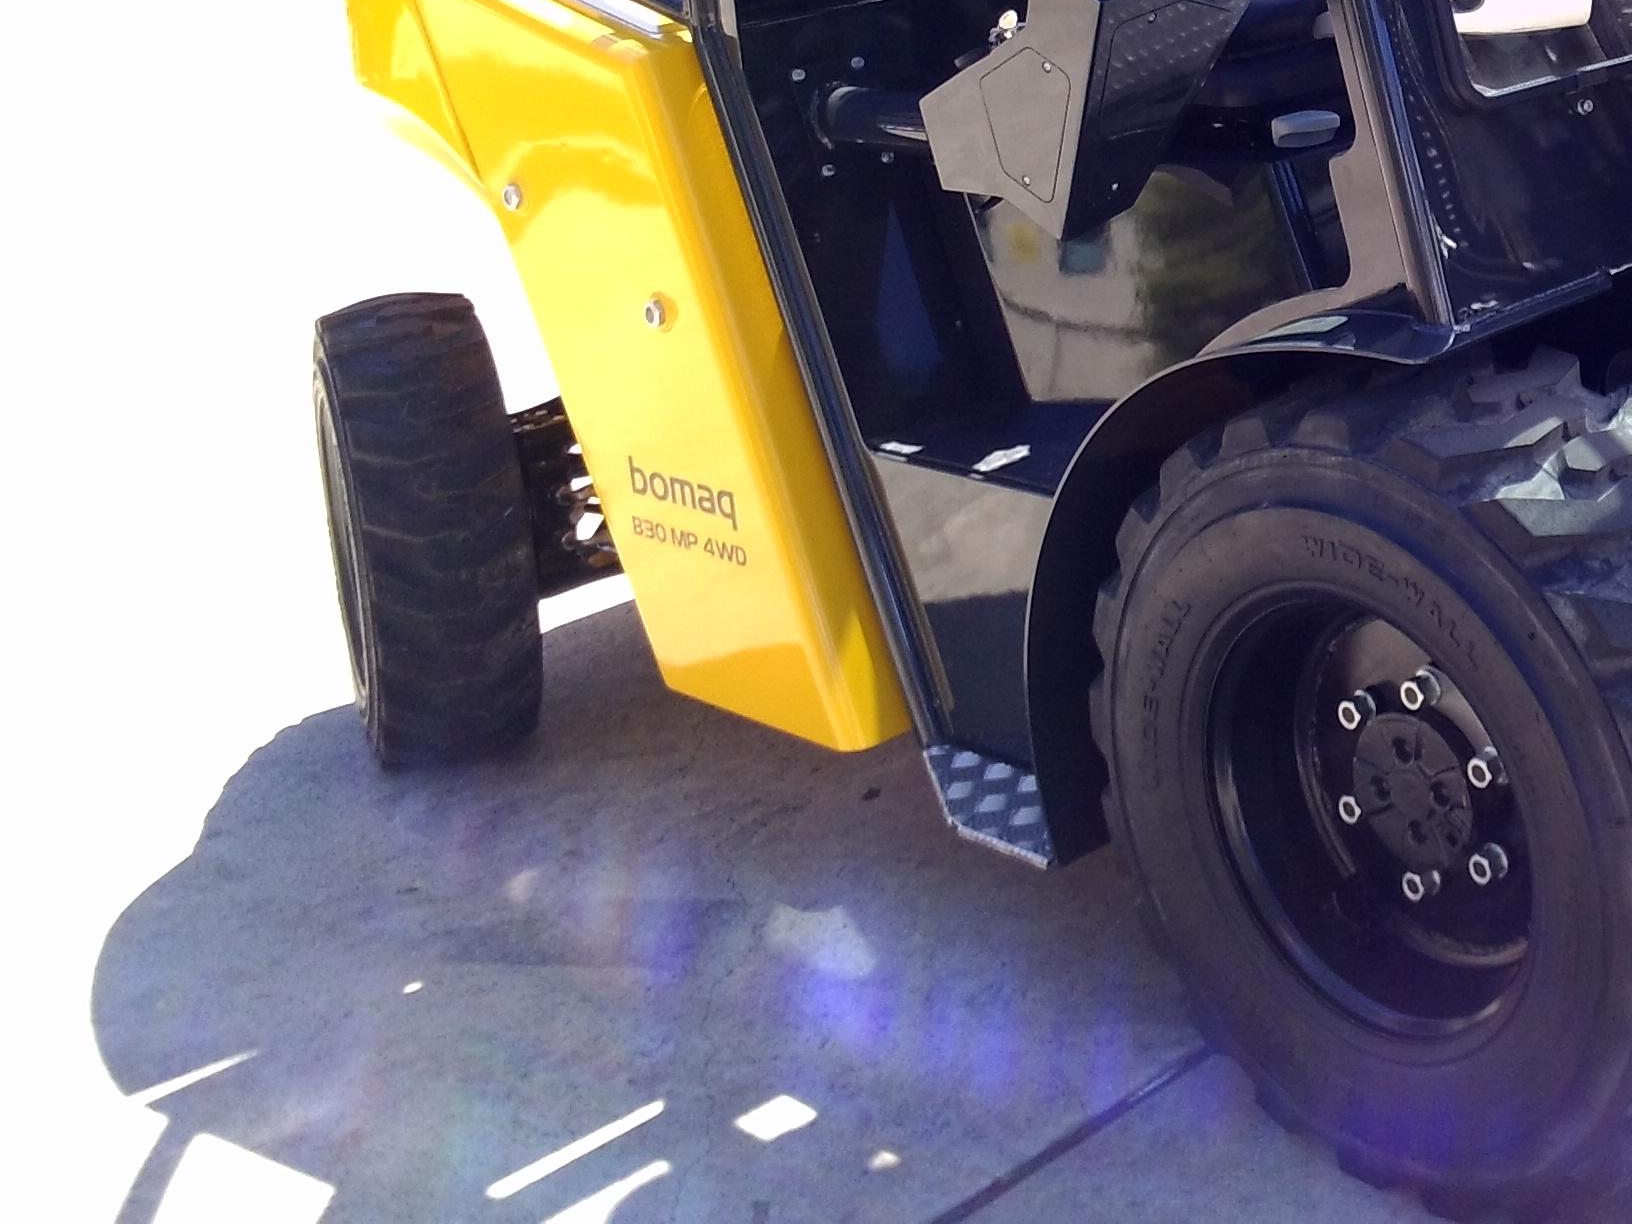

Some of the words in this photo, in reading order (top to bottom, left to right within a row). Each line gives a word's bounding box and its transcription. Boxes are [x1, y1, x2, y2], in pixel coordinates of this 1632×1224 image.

[628, 455, 738, 532] bomaq
[671, 527, 698, 550] MP
[703, 537, 747, 567] 4WD
